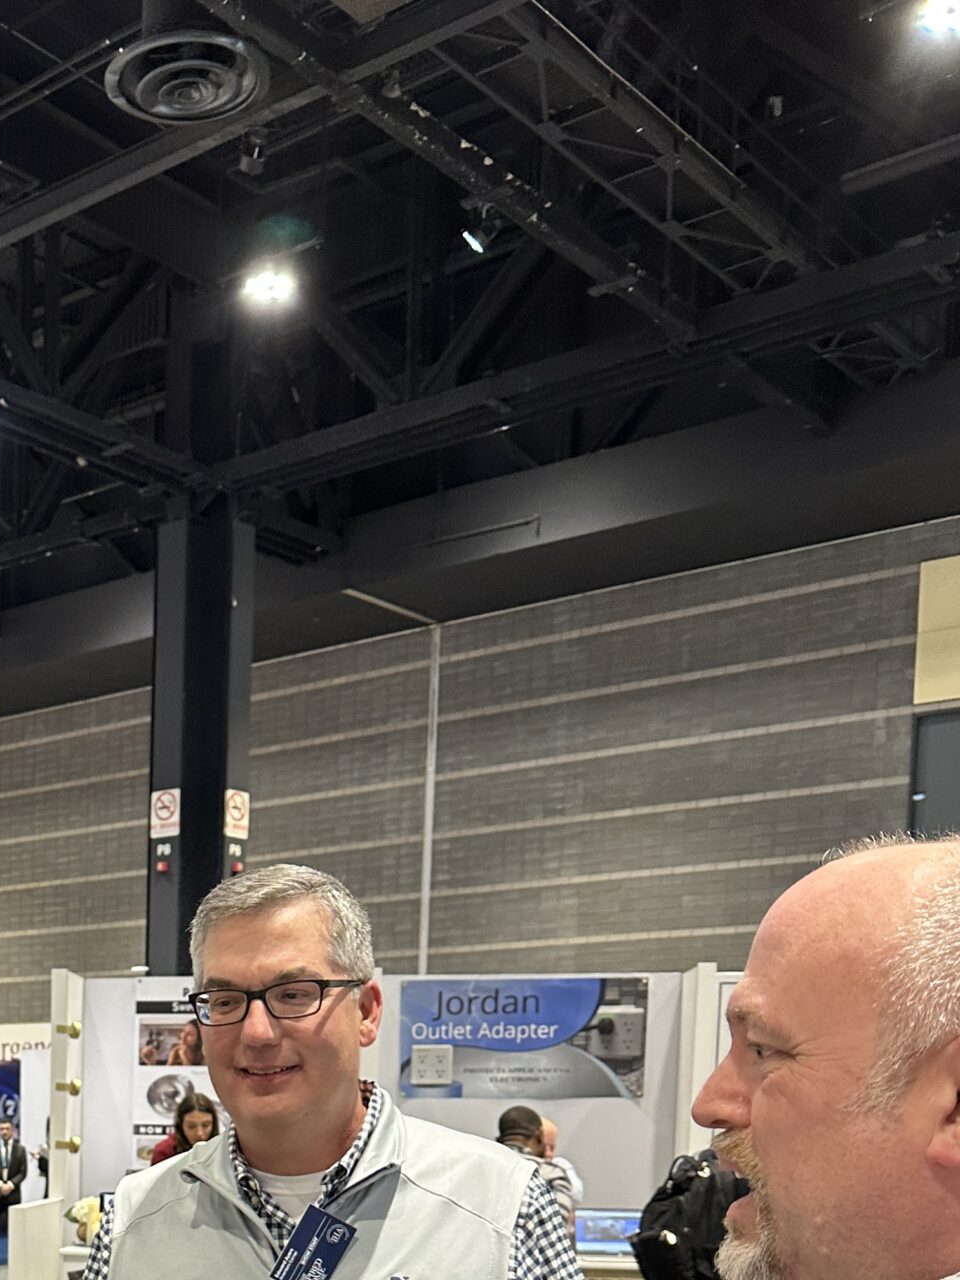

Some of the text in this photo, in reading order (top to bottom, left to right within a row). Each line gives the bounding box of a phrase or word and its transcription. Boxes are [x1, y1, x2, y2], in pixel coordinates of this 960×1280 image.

[432, 988, 539, 1021] Jordan
[411, 1022, 559, 1043] Outlet Adapter
